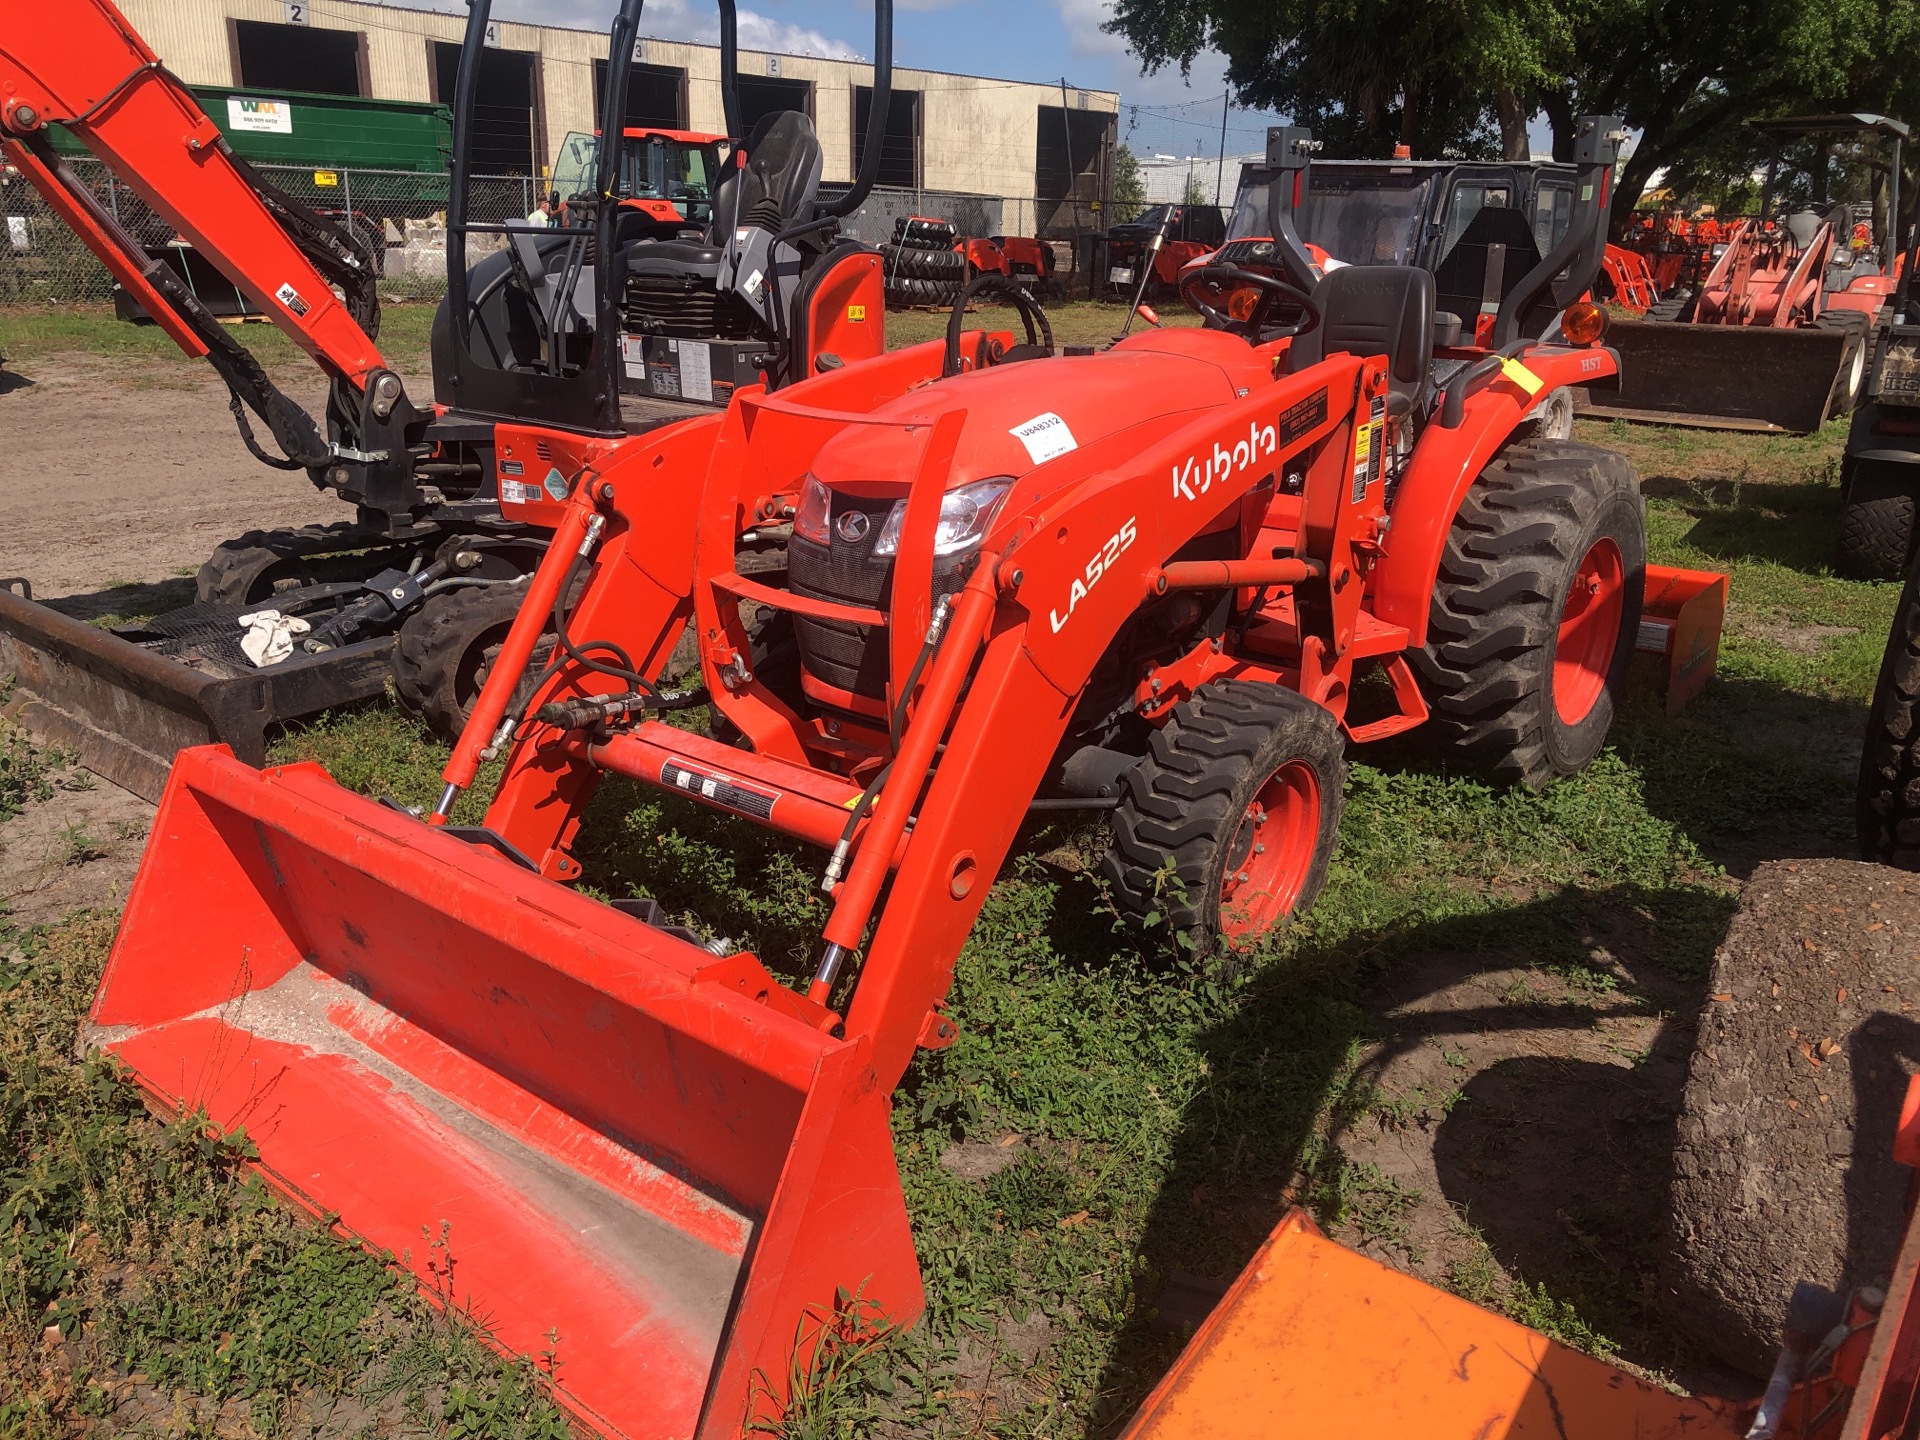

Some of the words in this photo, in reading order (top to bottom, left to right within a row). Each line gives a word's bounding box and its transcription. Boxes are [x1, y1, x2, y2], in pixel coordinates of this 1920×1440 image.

[291, 5, 302, 22] 2
[487, 26, 494, 41] 4
[635, 45, 642, 57] 3
[771, 59, 777, 71] 2
[240, 100, 277, 114] WM
[1581, 356, 1602, 372] HST
[1020, 416, 1061, 437] U848312
[1172, 421, 1276, 502] Kubota
[1049, 514, 1137, 635] LA525
